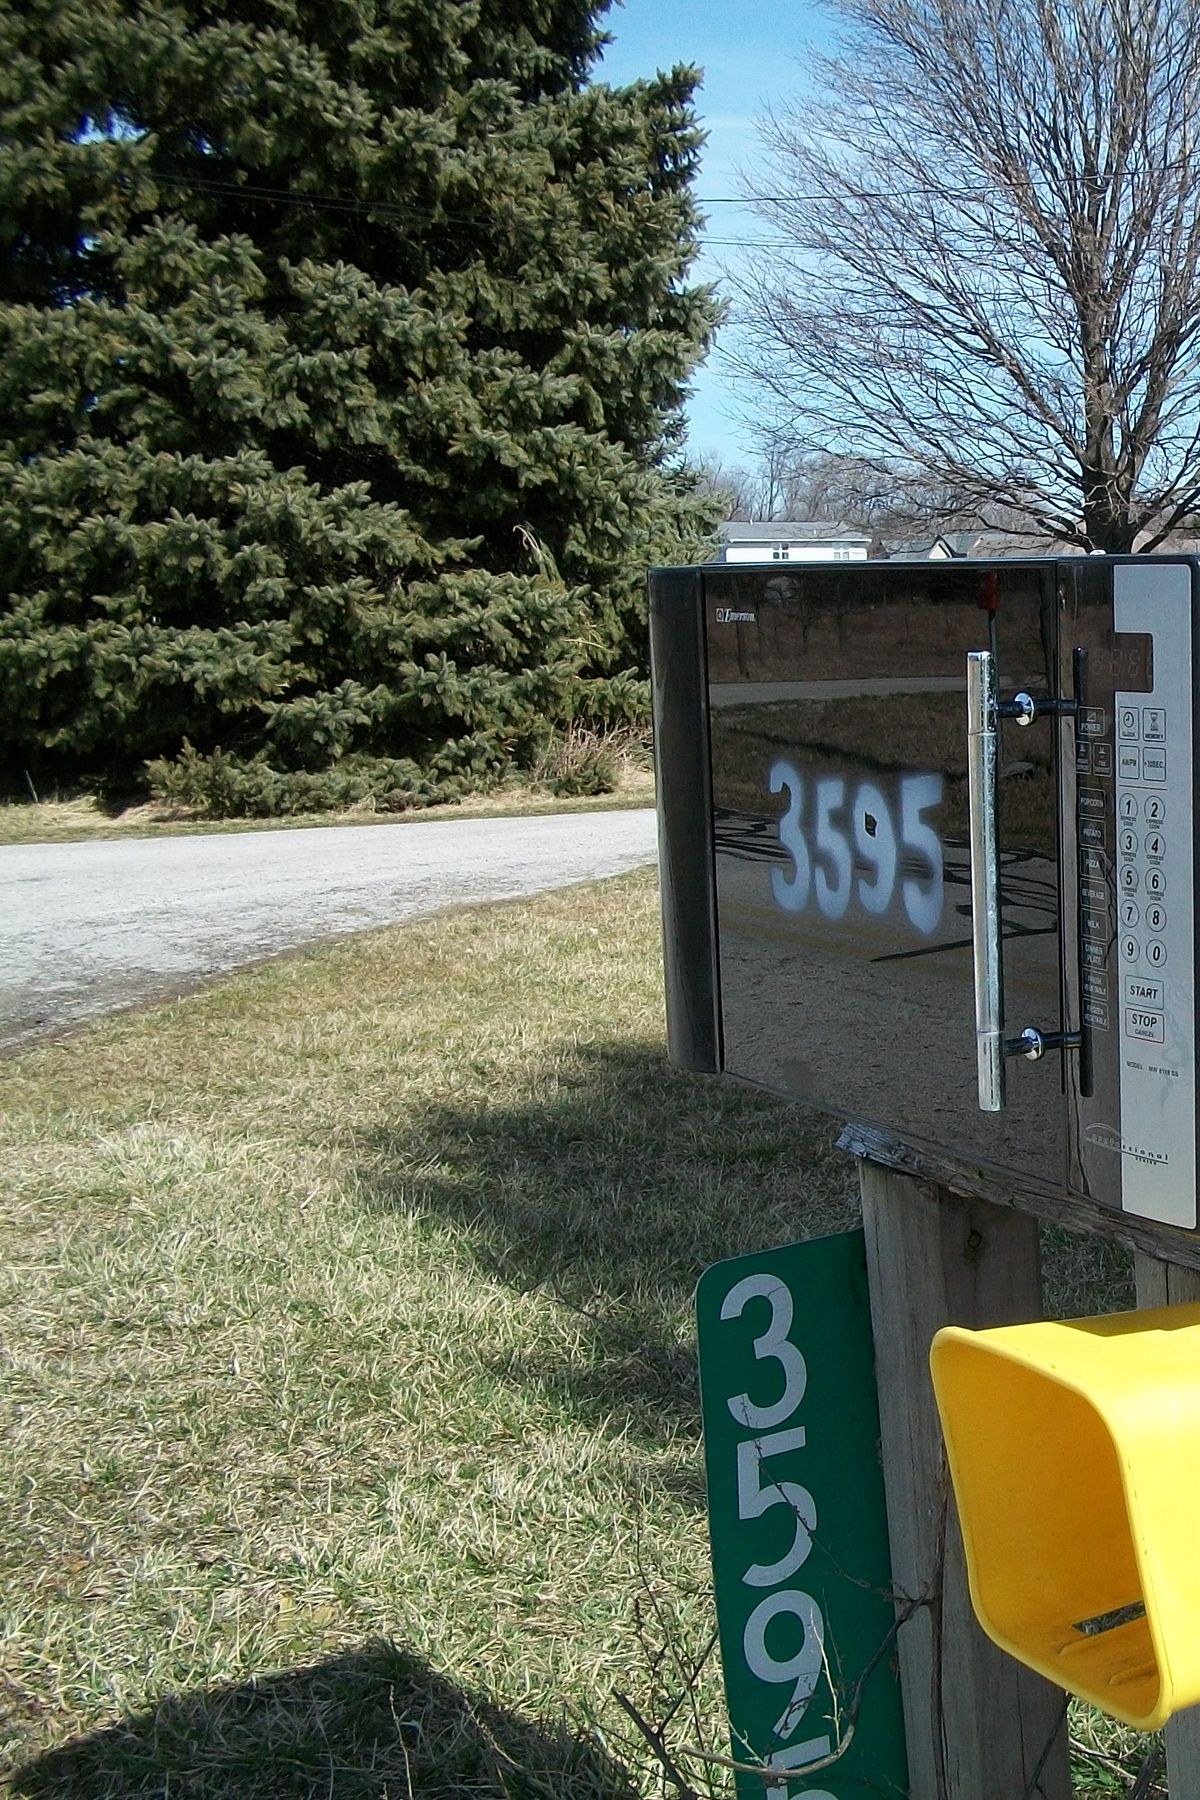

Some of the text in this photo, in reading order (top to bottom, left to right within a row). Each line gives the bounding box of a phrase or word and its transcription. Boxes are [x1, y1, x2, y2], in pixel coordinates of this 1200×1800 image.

[1081, 722, 1101, 732] POWER
[1081, 797, 1104, 808] POPCORN
[1125, 800, 1131, 815] 1
[1151, 802, 1158, 818] 2
[769, 760, 944, 935] 3595
[1125, 835, 1132, 851] 3
[1151, 838, 1158, 854] 4
[1086, 858, 1099, 868] PIZZA
[1126, 870, 1132, 886] 5
[1151, 873, 1159, 889] 6
[1127, 906, 1133, 921] 7
[1152, 909, 1160, 925] 8
[1127, 941, 1134, 957] 9
[1153, 945, 1160, 961] 0
[1129, 984, 1159, 1000] START
[1132, 1013, 1158, 1028] STOP
